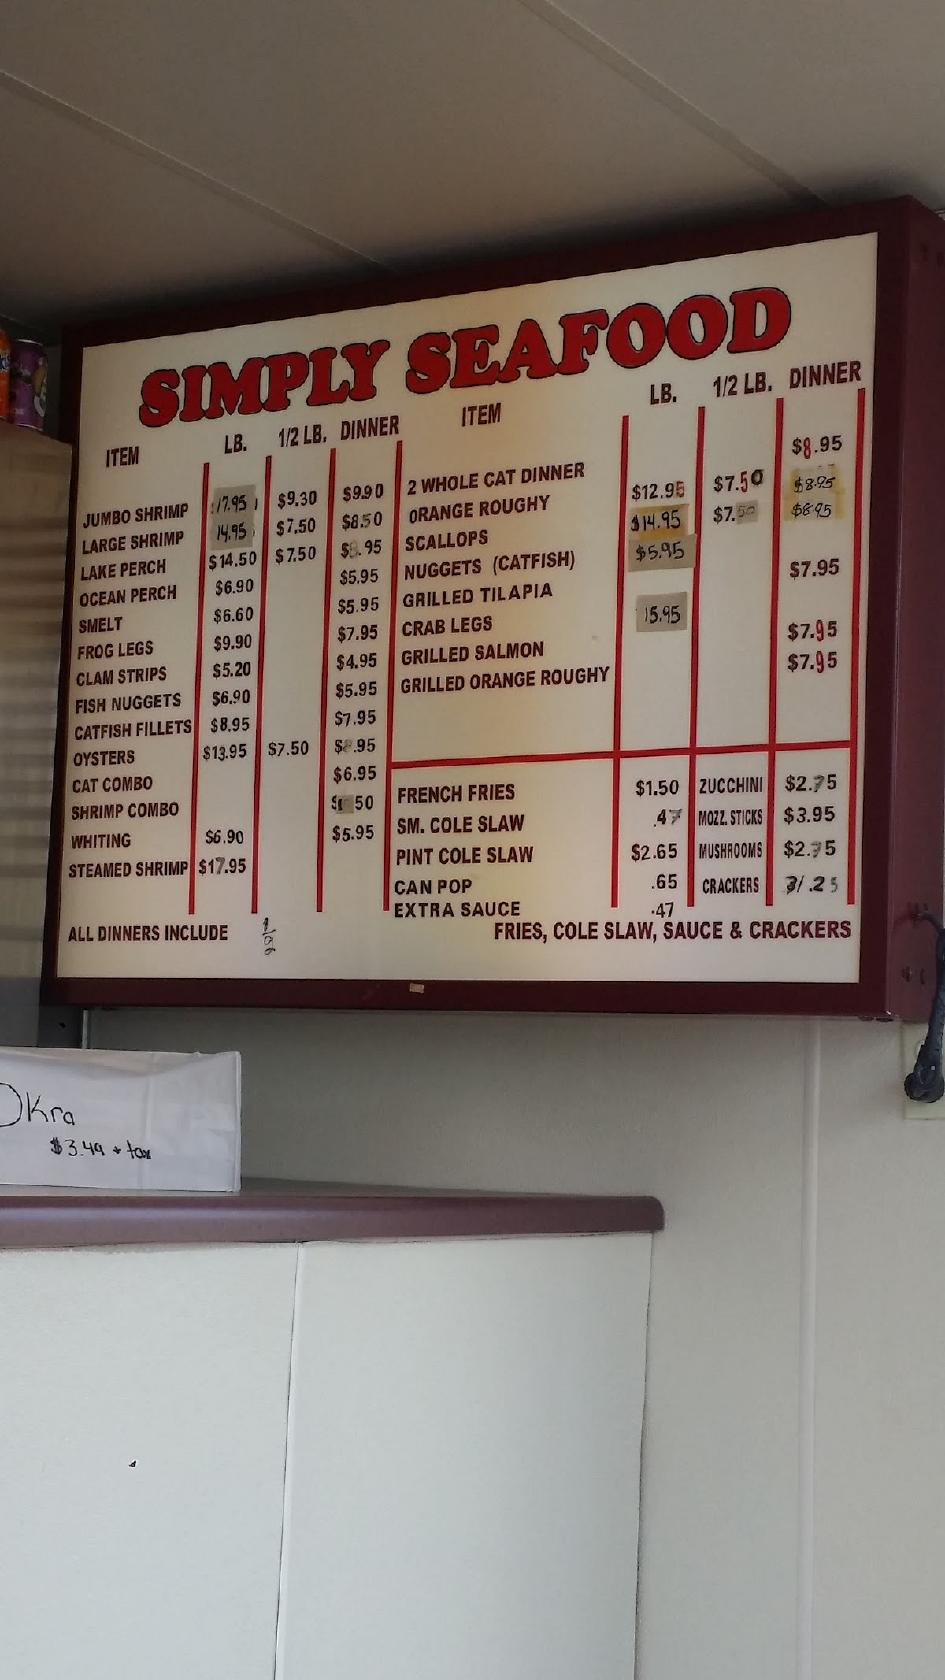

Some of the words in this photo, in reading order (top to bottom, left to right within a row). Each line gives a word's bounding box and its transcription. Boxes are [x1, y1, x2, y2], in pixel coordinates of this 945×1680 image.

[138, 339, 391, 427] SIMPLY
[405, 287, 791, 395] SEAFOOD
[714, 375, 738, 398] 1/2
[744, 372, 773, 395] LB.
[789, 361, 861, 389] DINNER
[650, 383, 677, 406] LB.
[462, 402, 501, 427] ITEM
[279, 426, 299, 448] 1/2
[304, 425, 327, 445] LB.
[340, 416, 399, 440] DINNER
[224, 434, 247, 454] LB.
[791, 435, 843, 459] $8.95
[106, 446, 139, 468] ITEM
[408, 478, 417, 495] 2
[421, 472, 479, 494] WHOLE
[483, 468, 516, 488] CAT
[521, 462, 585, 484] DINNER
[713, 469, 764, 493] $7.50
[278, 490, 317, 509] $9.30
[343, 483, 384, 502] $9.90
[631, 481, 685, 501] $12.95
[82, 512, 131, 529] JUMBO
[134, 503, 189, 523] SHRIMP
[479, 495, 551, 520] ROUGHY
[276, 517, 316, 537] $7.50
[341, 511, 382, 531] $8.50
[630, 510, 682, 532] $14.95
[82, 538, 127, 555] LARGE
[130, 531, 184, 550] SHRIMP
[405, 529, 489, 552] SCALLOPS
[208, 551, 257, 570] $14.50
[275, 546, 316, 565] $7.50
[635, 541, 685, 562] $5.95
[80, 564, 116, 581] LAKE
[120, 559, 166, 577] PERCH
[404, 558, 482, 580] NUGGETS
[493, 551, 576, 576] (CATFISH)
[789, 558, 840, 579] $7.95
[340, 569, 379, 586] $5.95
[79, 590, 126, 607] OCEAN
[130, 585, 177, 603] PERCH
[215, 579, 254, 597] $6.90
[402, 588, 473, 609] GRILLED
[480, 582, 553, 603] TILAPIA
[213, 606, 254, 624] $6.60
[338, 598, 379, 615] $5.95
[643, 605, 681, 624] 15.95
[79, 617, 122, 633] SMELT
[337, 625, 378, 643] $7.95
[401, 619, 447, 637] CRAB
[451, 615, 493, 634] LEGS
[787, 619, 838, 641] $7.95
[77, 643, 114, 660] FROG
[118, 641, 153, 656] LEGS
[213, 634, 252, 652] $9.90
[336, 653, 377, 671] $4.95
[401, 646, 470, 666] GRILLED
[474, 641, 545, 662] SALMON
[787, 650, 838, 672] $7.95
[76, 670, 114, 687] CLAM
[118, 667, 167, 684] STRIPS
[212, 661, 251, 679] $5.20
[400, 674, 464, 694] GRILLED
[469, 670, 536, 691] ORANGE
[540, 665, 611, 687] ROUGHY
[212, 689, 251, 706] $6.90
[335, 682, 377, 699] $5.95
[75, 697, 106, 714] FISH
[111, 693, 181, 711] NUGGETS
[210, 717, 250, 734] $8.95
[334, 710, 377, 726] $7.95
[74, 722, 132, 740] CATFISH
[136, 720, 192, 737] FILLETS
[73, 750, 135, 766] OYSTERS
[203, 744, 247, 761] $13.95
[268, 741, 309, 757] $7.50
[72, 777, 98, 793] CAT
[102, 776, 153, 792] COMBO
[333, 765, 377, 784] $6.95
[785, 773, 837, 794] $2.75
[397, 785, 463, 804] FRENCH
[468, 783, 515, 802] FRIES
[635, 779, 679, 797] $1.50
[699, 776, 763, 795] ZUCCHINI
[71, 803, 124, 820] SHRIMP
[127, 802, 179, 818] COMBO
[698, 808, 726, 827] MOZZ.
[729, 808, 763, 827] STICKS
[783, 805, 835, 825] $3.95
[332, 825, 374, 842] $5.95
[396, 817, 425, 836] SM.
[430, 816, 473, 834] COLE
[478, 814, 525, 833] SLAW
[71, 833, 132, 850] WHITING
[205, 829, 244, 846] $6.90
[396, 847, 433, 866] PINT
[437, 846, 482, 864] COLE
[486, 845, 533, 863] SLAW
[631, 842, 678, 862] $2.65
[699, 841, 763, 859] MUSHROOMS
[68, 862, 132, 879] STEAMED
[135, 860, 188, 877] SHRIMP
[199, 857, 247, 875] $17.95
[394, 879, 432, 896] CAN
[437, 878, 472, 895] POP
[650, 873, 678, 891] .65
[702, 876, 760, 895] CRACKERS
[394, 901, 454, 919] EXTRA
[460, 901, 521, 917] SAUCE
[650, 902, 675, 920] .47
[68, 926, 94, 942] ALL
[98, 925, 160, 942] DINNERS
[164, 924, 228, 940] INCLUDE
[494, 922, 548, 943] FRIES,
[553, 922, 599, 941] COLE
[603, 921, 658, 943] SLAW,
[663, 921, 724, 940] SAUCE
[730, 921, 744, 940] &
[749, 920, 852, 940] CRACKERS
[126, 1139, 152, 1159] tax
